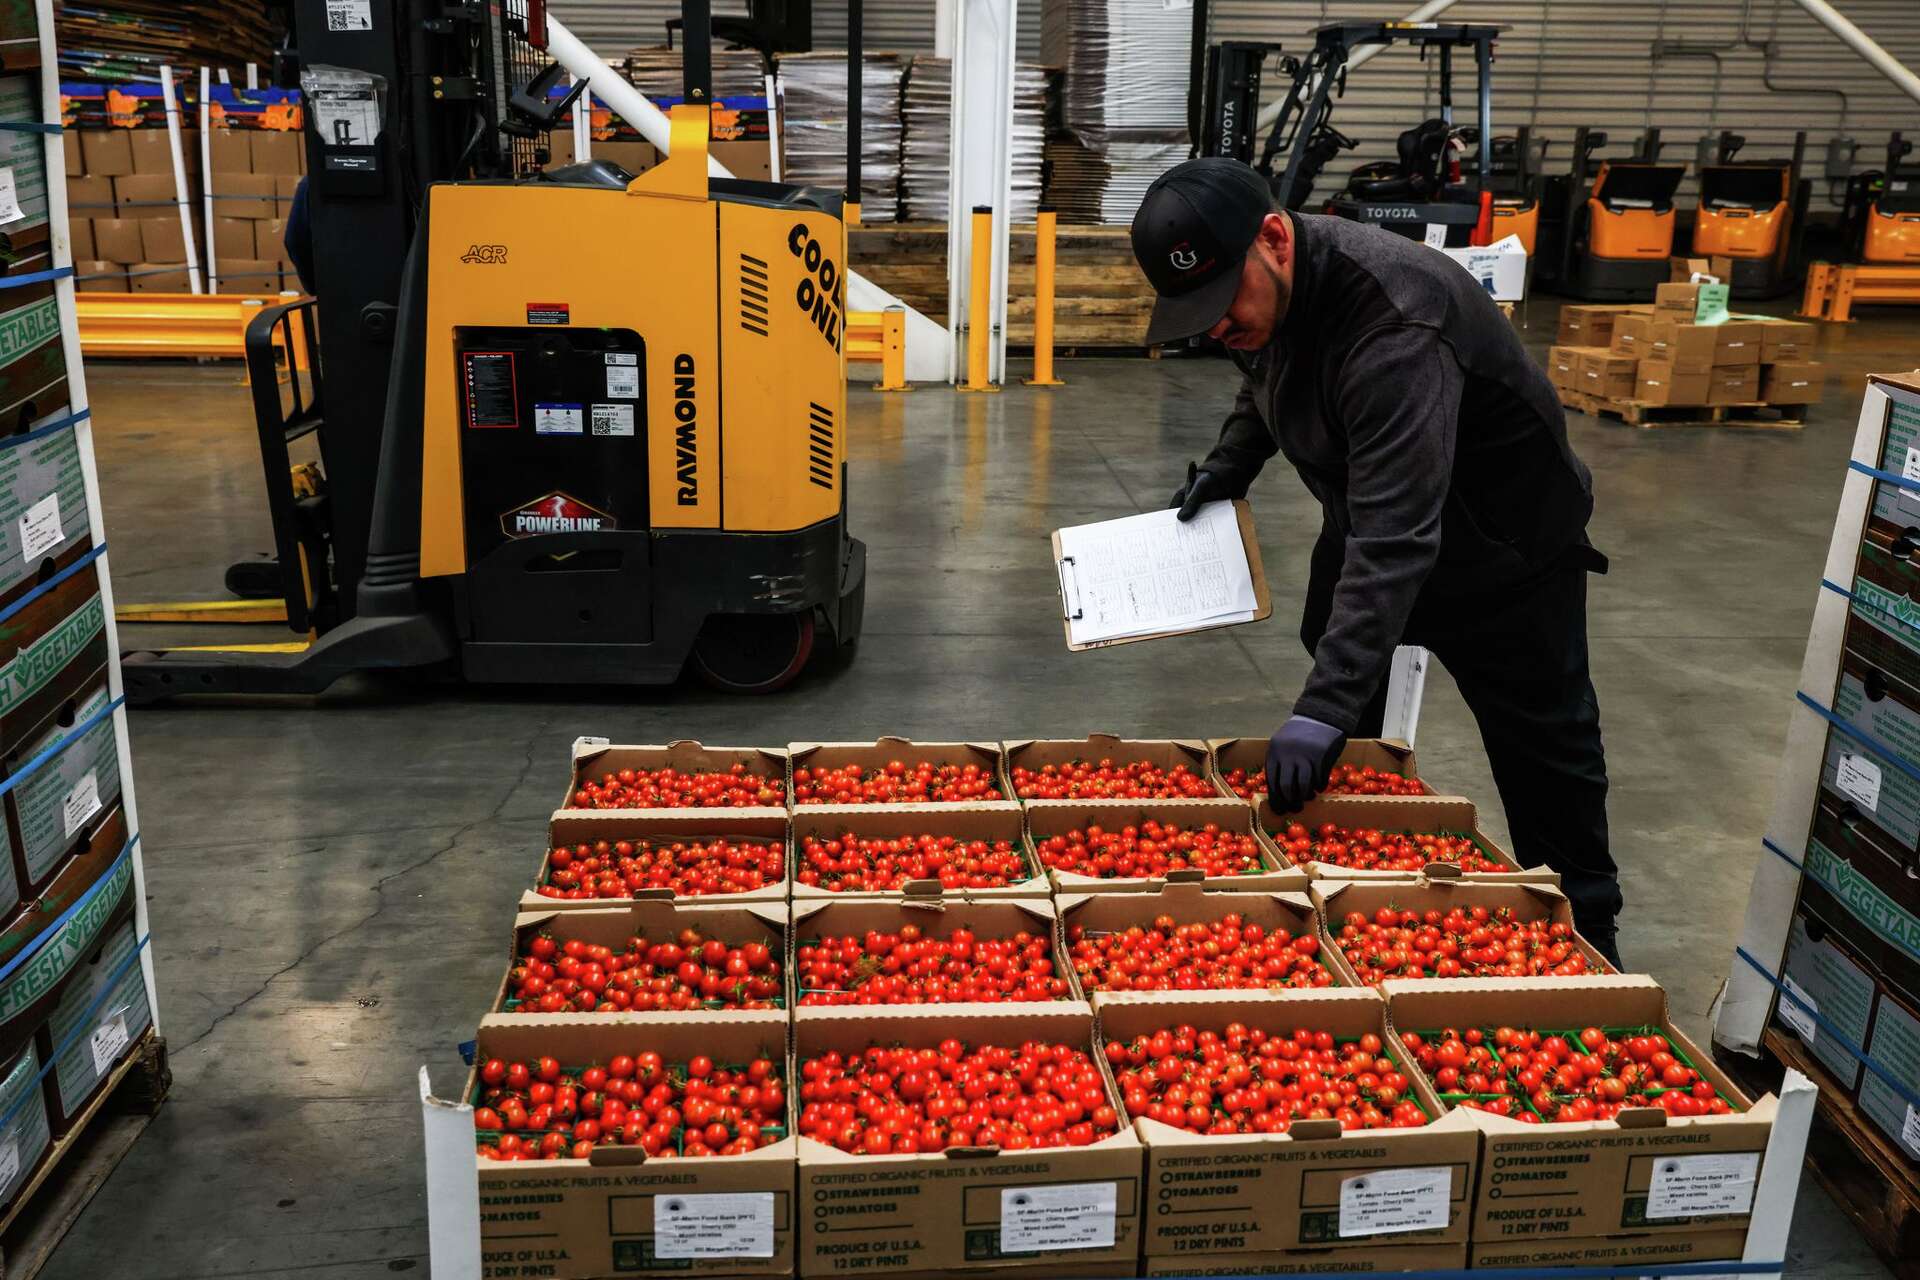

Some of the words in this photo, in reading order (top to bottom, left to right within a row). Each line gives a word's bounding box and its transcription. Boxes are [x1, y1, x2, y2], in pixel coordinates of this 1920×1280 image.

[1221, 101, 1235, 154] TOYOTA
[1367, 208, 1417, 218] TOYOTA
[460, 244, 508, 264] ACR
[787, 224, 841, 311] COOL
[0, 303, 59, 354] ETABLES
[674, 353, 698, 506] RAYMOND
[516, 515, 601, 533] POWERLINE
[1836, 863, 1920, 950] VEGETAB
[0, 944, 66, 1017] FRESH
[1493, 1141, 1545, 1153] CERTIFIED
[1545, 1138, 1598, 1151] ORGANIC
[1599, 1136, 1634, 1147] FRUITS
[1637, 1135, 1645, 1146] &
[1646, 1133, 1711, 1146] VEGETABLES
[1157, 1156, 1212, 1168] CERTIFIED
[1213, 1153, 1267, 1165] ORGANIC
[1269, 1151, 1306, 1163] FRUITS
[1309, 1150, 1319, 1160] &
[1321, 1148, 1387, 1160] VEGETABLES
[1507, 1153, 1590, 1167] STRAWBERRIES
[810, 1173, 866, 1185] CERTIFIED
[869, 1169, 926, 1182] ORGANIC
[928, 1168, 966, 1179] FRUITS
[969, 1166, 978, 1177] &
[980, 1162, 1050, 1177] VEGETABLES
[1174, 1168, 1262, 1182] STRAWBERRIES
[1502, 1170, 1568, 1182] TOMATOES
[507, 1178, 568, 1190] ORGANIC
[571, 1176, 611, 1188] FRUITS
[614, 1176, 623, 1186] &
[624, 1174, 698, 1186] VEGETABLES
[479, 1193, 564, 1205] TRAWBERRIES
[829, 1184, 921, 1200] STRAWBERRIES
[1171, 1185, 1239, 1198] TOMATOES
[480, 1210, 541, 1222] OMATOES
[828, 1202, 898, 1216] TOMATOES
[1486, 1209, 1537, 1221] PRODUCE
[1538, 1207, 1554, 1219] OF
[1555, 1207, 1586, 1218] U.S.A.
[1157, 1224, 1210, 1237] PRODUCE
[1211, 1222, 1228, 1235] OF
[1229, 1222, 1261, 1233] U.S.A.
[1501, 1223, 1513, 1235] 12
[1516, 1222, 1537, 1234] DRY
[1539, 1220, 1570, 1232] PINTS
[815, 1242, 871, 1256] PRODUCE
[872, 1240, 888, 1252] OF
[890, 1239, 925, 1251] U.S.A.
[1172, 1239, 1187, 1251] 12
[1189, 1238, 1212, 1249] DRY
[1213, 1236, 1245, 1248] PINTS
[482, 1251, 513, 1263] DUCE
[517, 1250, 534, 1262] OF
[536, 1249, 571, 1260] U.S.A.
[833, 1257, 848, 1269] 12
[850, 1256, 873, 1268] DRY
[875, 1254, 909, 1266] PINTS
[1479, 1255, 1530, 1266] CERTIFIED
[1531, 1250, 1582, 1262] ORGANIC
[1583, 1248, 1618, 1260] FRUITS
[1621, 1247, 1628, 1256] &
[1630, 1243, 1693, 1256] VEGETABLES
[494, 1265, 517, 1278] DRY
[521, 1264, 556, 1276] PINTS
[1151, 1267, 1203, 1278] CERTIFIED
[1204, 1265, 1258, 1277] ORGANIC
[1260, 1263, 1296, 1275] FRUITS
[1297, 1263, 1306, 1274] &
[1308, 1261, 1374, 1273] VEGETABLES
